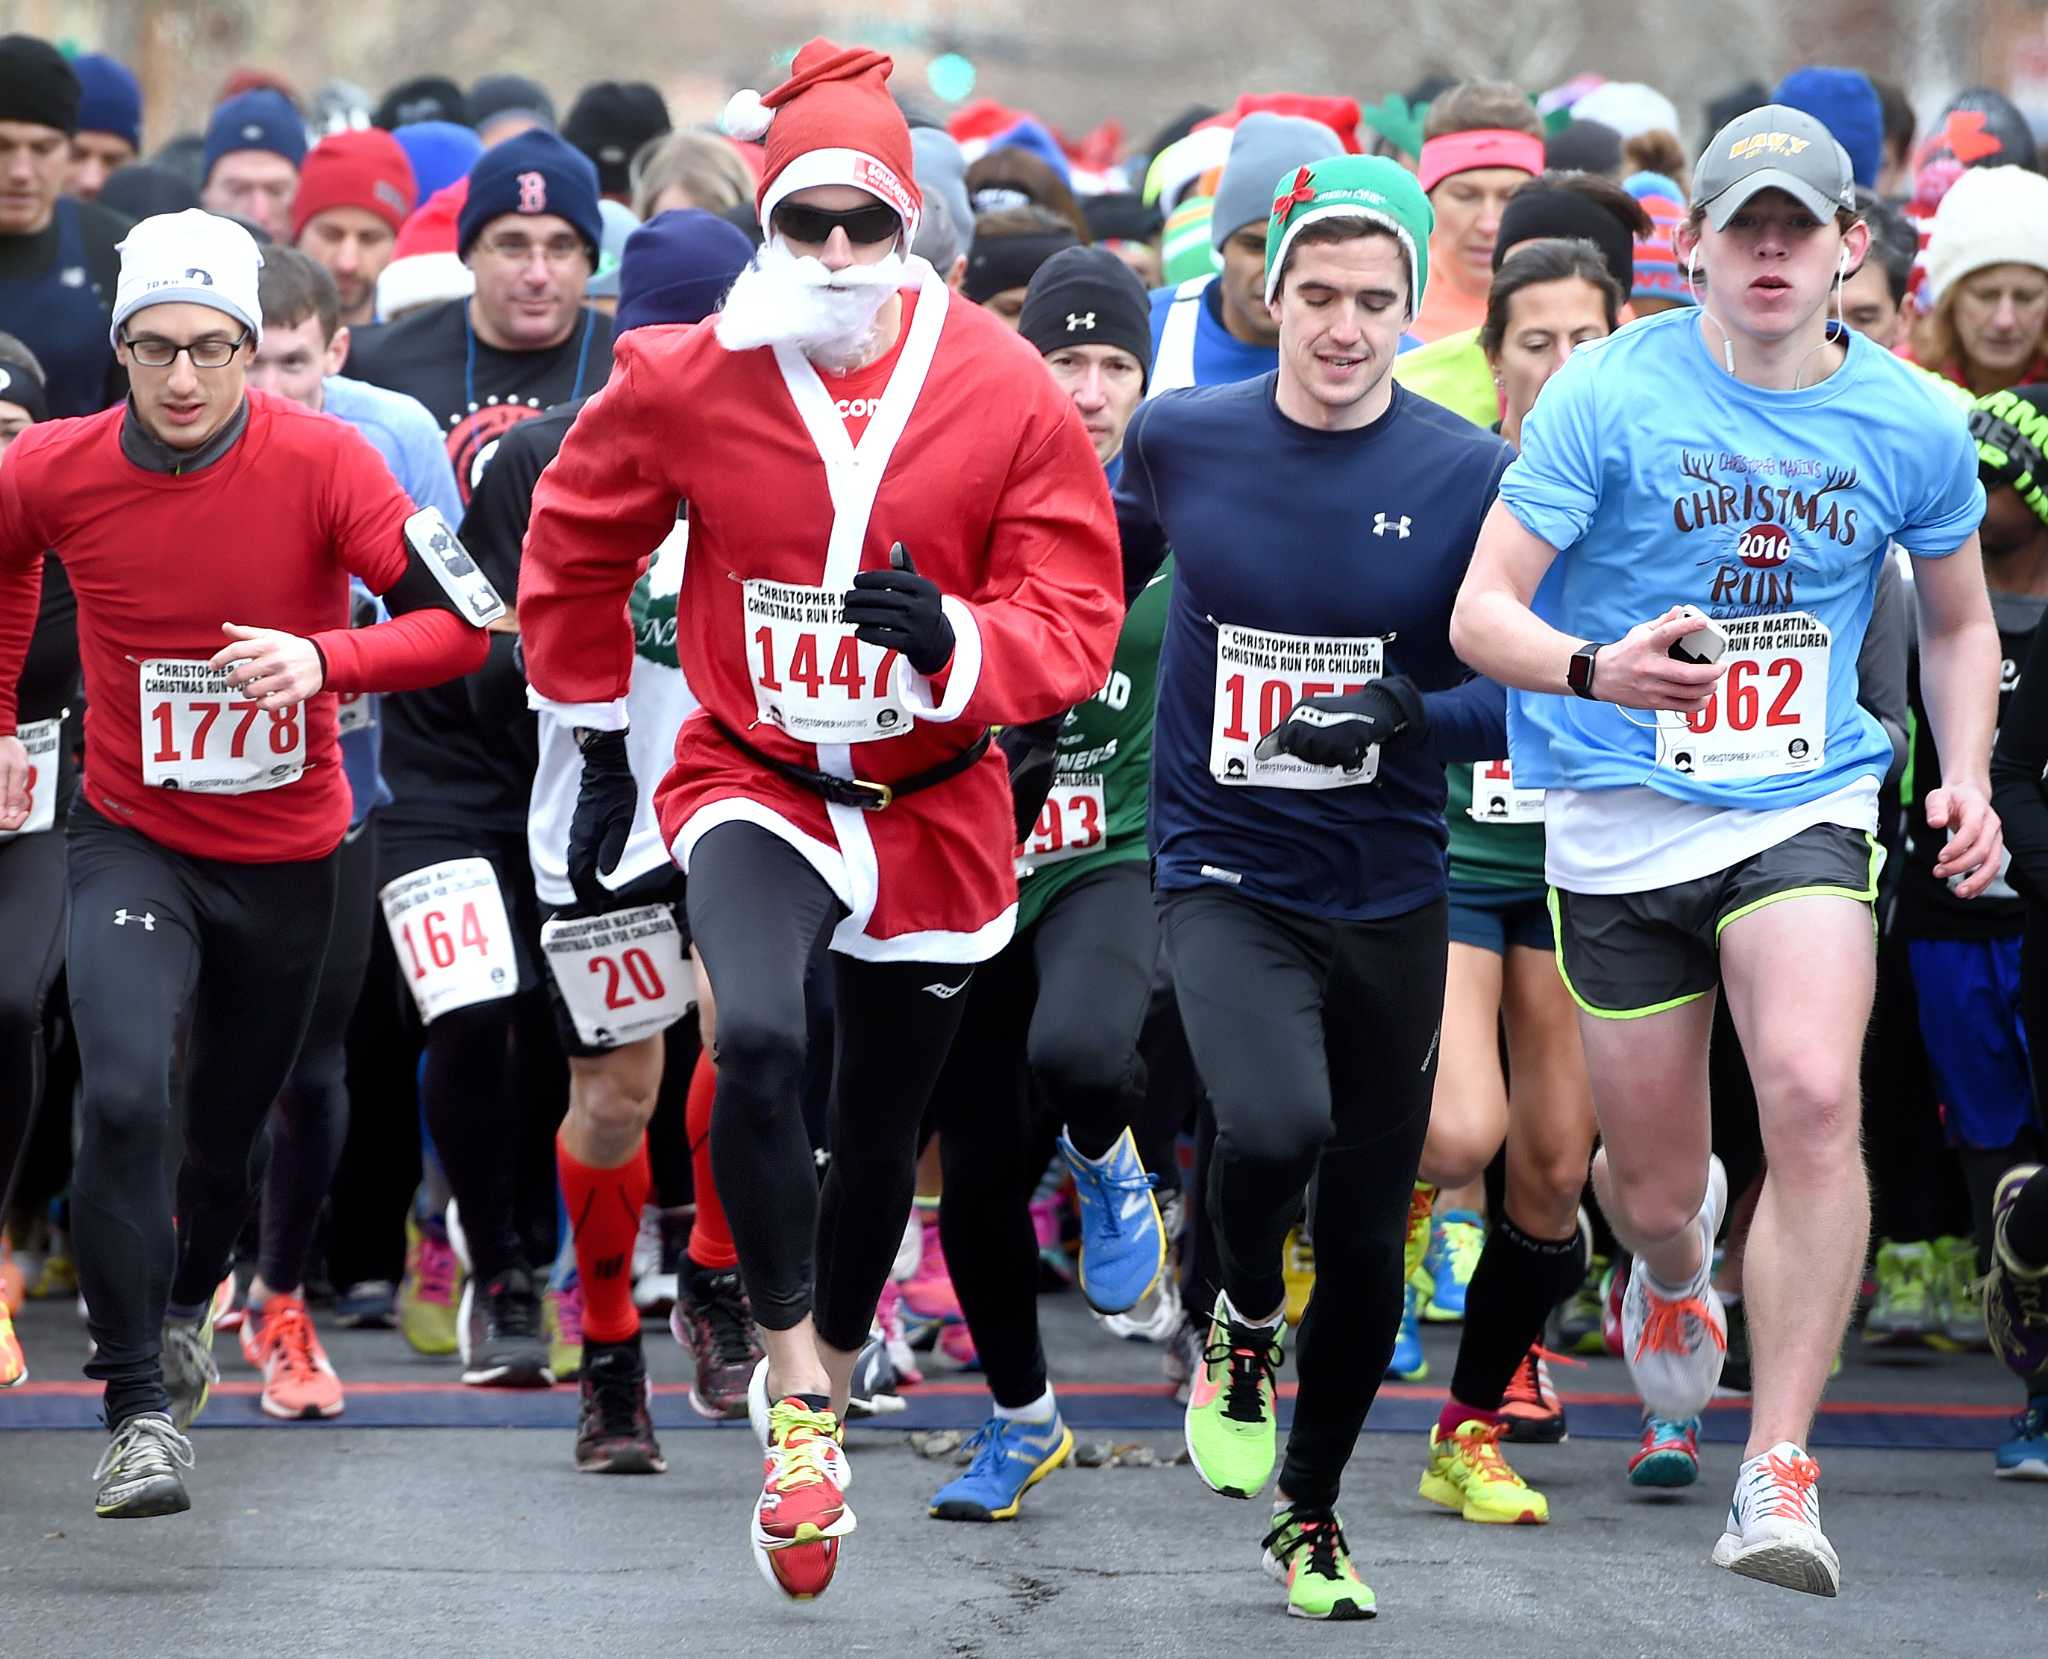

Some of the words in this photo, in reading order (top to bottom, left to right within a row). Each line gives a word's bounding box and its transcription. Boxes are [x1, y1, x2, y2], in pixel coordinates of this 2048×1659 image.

[1728, 132, 1812, 160] NAVY
[516, 171, 547, 211] B
[1674, 484, 1858, 546] CHRISTMAS
[1736, 533, 1792, 560] 2016
[758, 583, 835, 606] CHRISTOPHER
[1711, 564, 1794, 605] RUN
[748, 598, 803, 623] CHRISTMAS
[806, 609, 828, 624] RUN
[832, 610, 843, 624] FO
[1221, 645, 1277, 670] CHRISTMAS
[1280, 657, 1301, 671] RUN
[1305, 658, 1325, 673] FOR
[1328, 659, 1380, 675] CHILDREN
[1232, 631, 1310, 655] CHRISTOPHER
[1313, 642, 1369, 657] MARTINS
[1728, 637, 1750, 652] RUN
[1753, 635, 1773, 650] FOR
[1776, 633, 1828, 649] CHILDREN
[755, 626, 898, 699] 1447
[145, 679, 204, 694] CHRISTMAS
[207, 680, 228, 694] RUN
[152, 702, 299, 762] 1778
[1016, 796, 1101, 857] 93
[402, 901, 489, 980] 164
[588, 947, 666, 1011] 20
